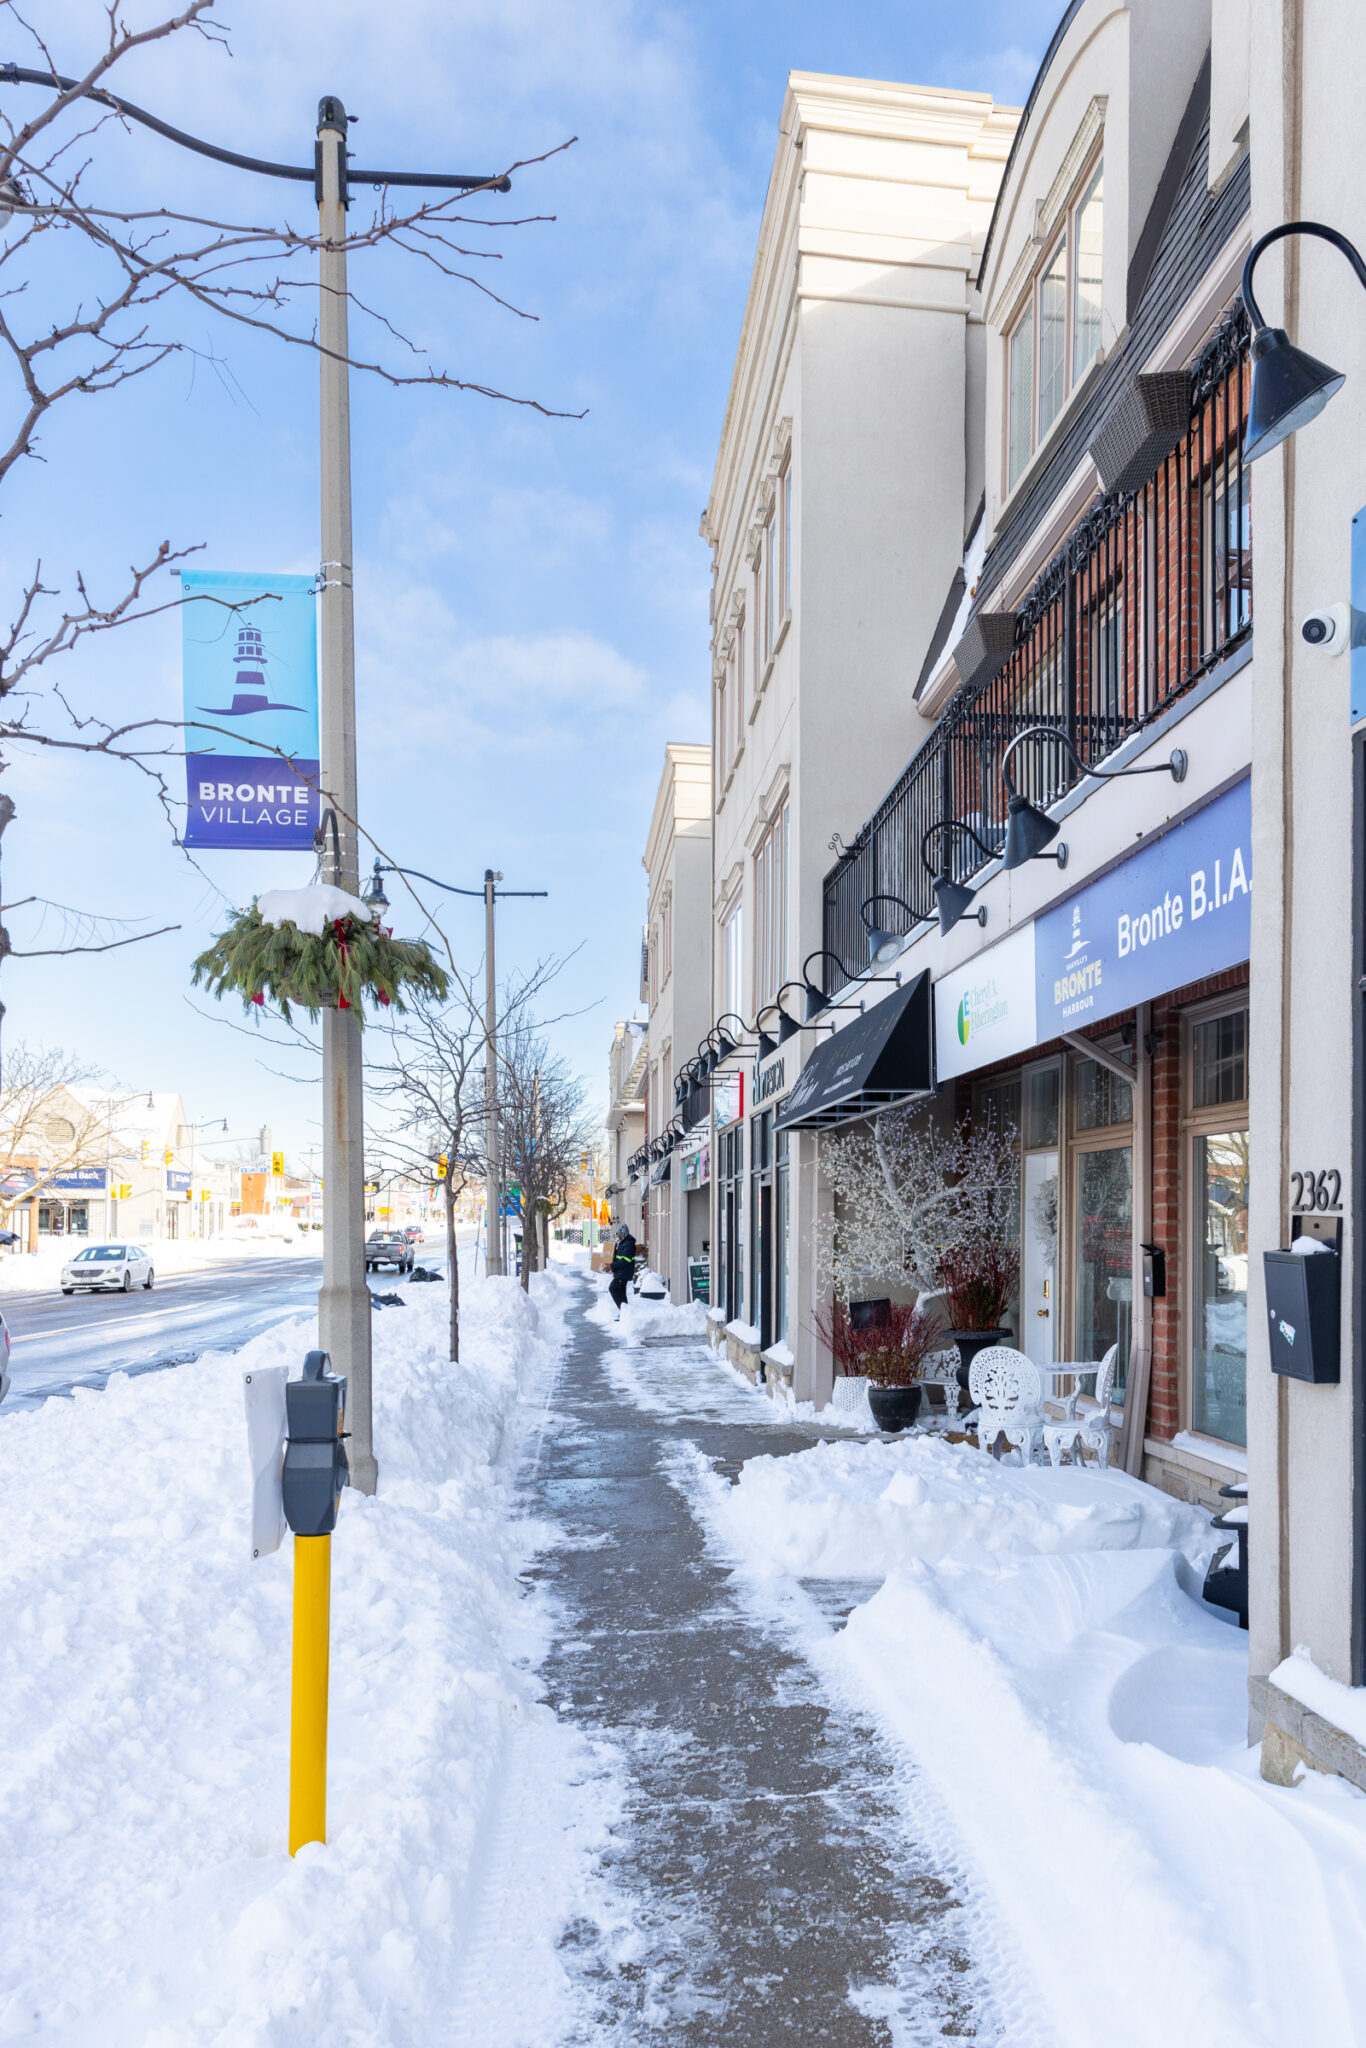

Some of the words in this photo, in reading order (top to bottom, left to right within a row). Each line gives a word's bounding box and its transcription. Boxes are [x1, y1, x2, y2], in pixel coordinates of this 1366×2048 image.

[199, 782, 309, 804] BRONTE
[200, 806, 308, 826] VILLAGE
[1118, 891, 1184, 959] Bronte
[1054, 959, 1103, 1005] BRONTE
[1062, 995, 1094, 1018] HARBOUR
[1291, 1169, 1343, 1211] 2362
